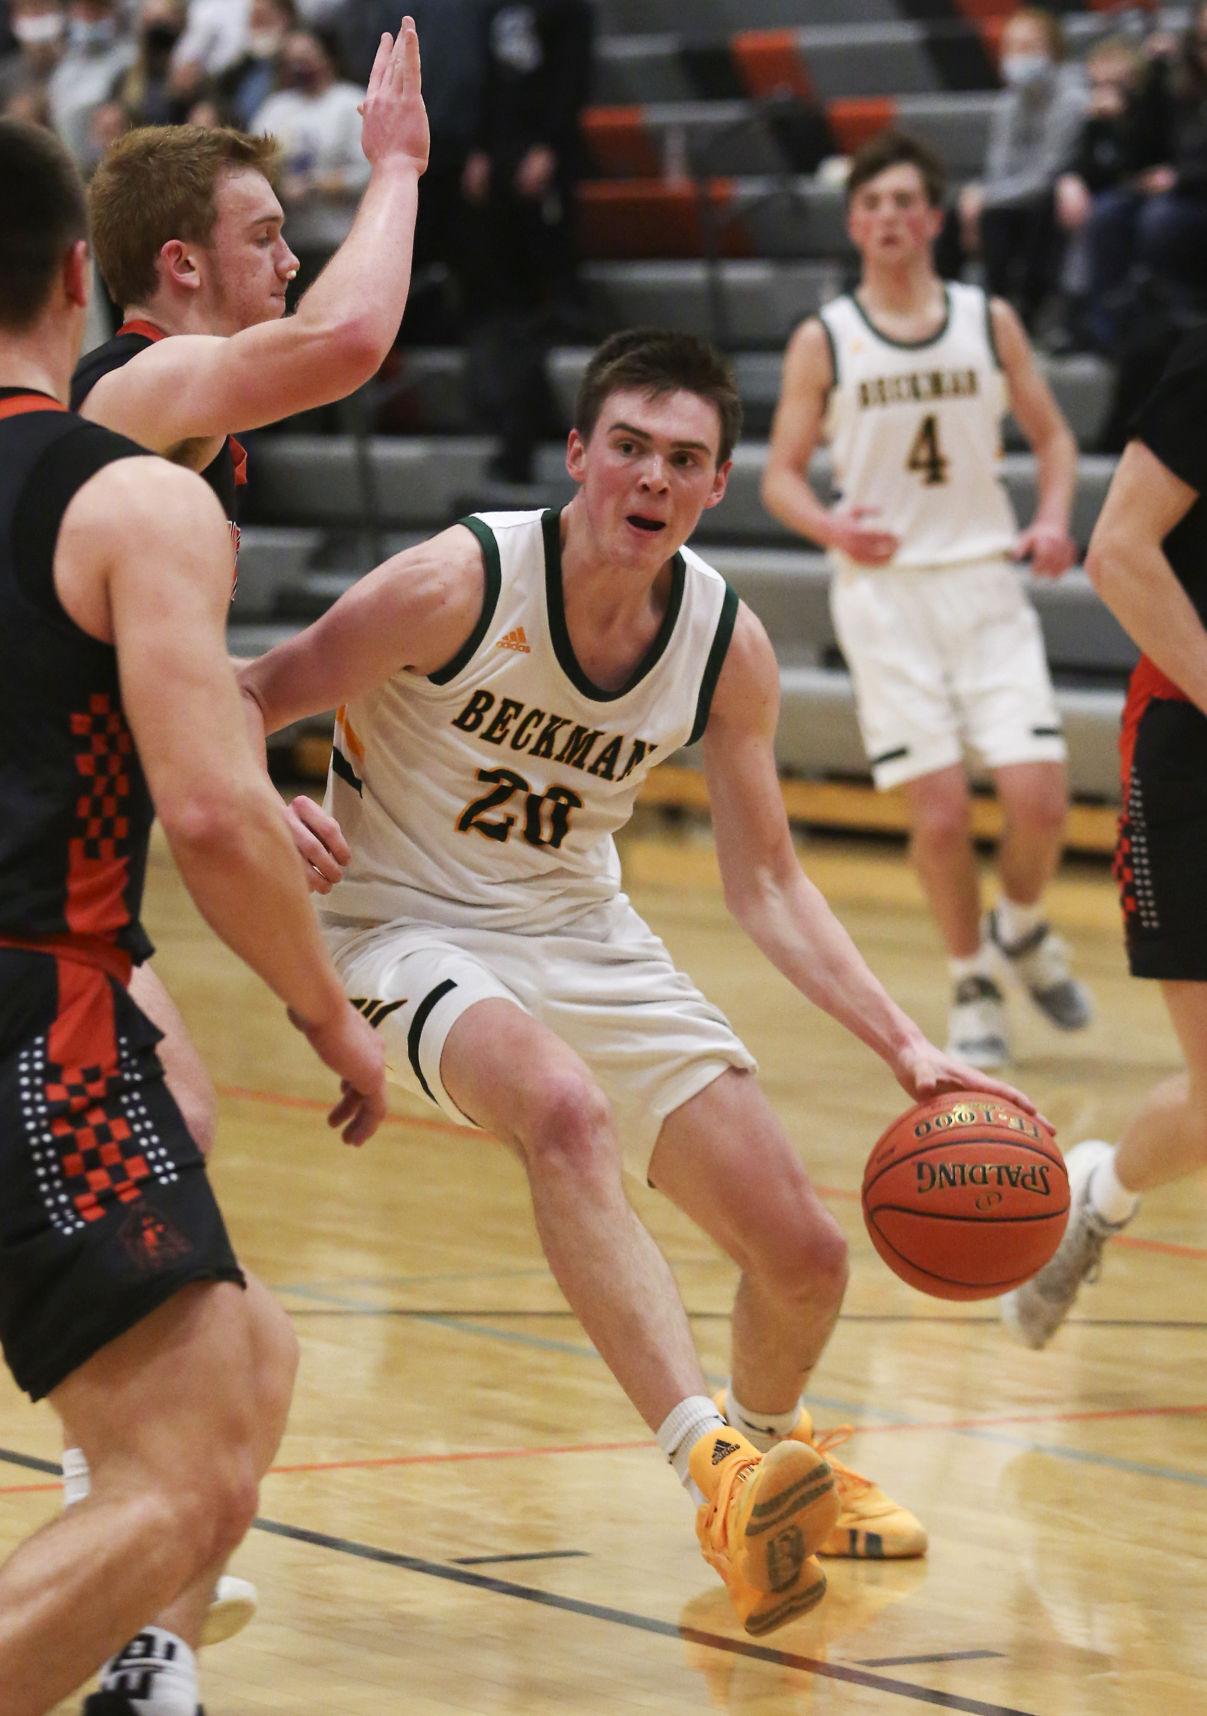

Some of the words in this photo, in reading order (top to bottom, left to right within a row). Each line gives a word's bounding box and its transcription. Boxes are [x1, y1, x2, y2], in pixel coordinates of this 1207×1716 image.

[905, 412, 950, 487] 4
[451, 689, 658, 782] BECKMAN
[454, 767, 584, 849] 20
[915, 1162, 1050, 1196] SPALDING
